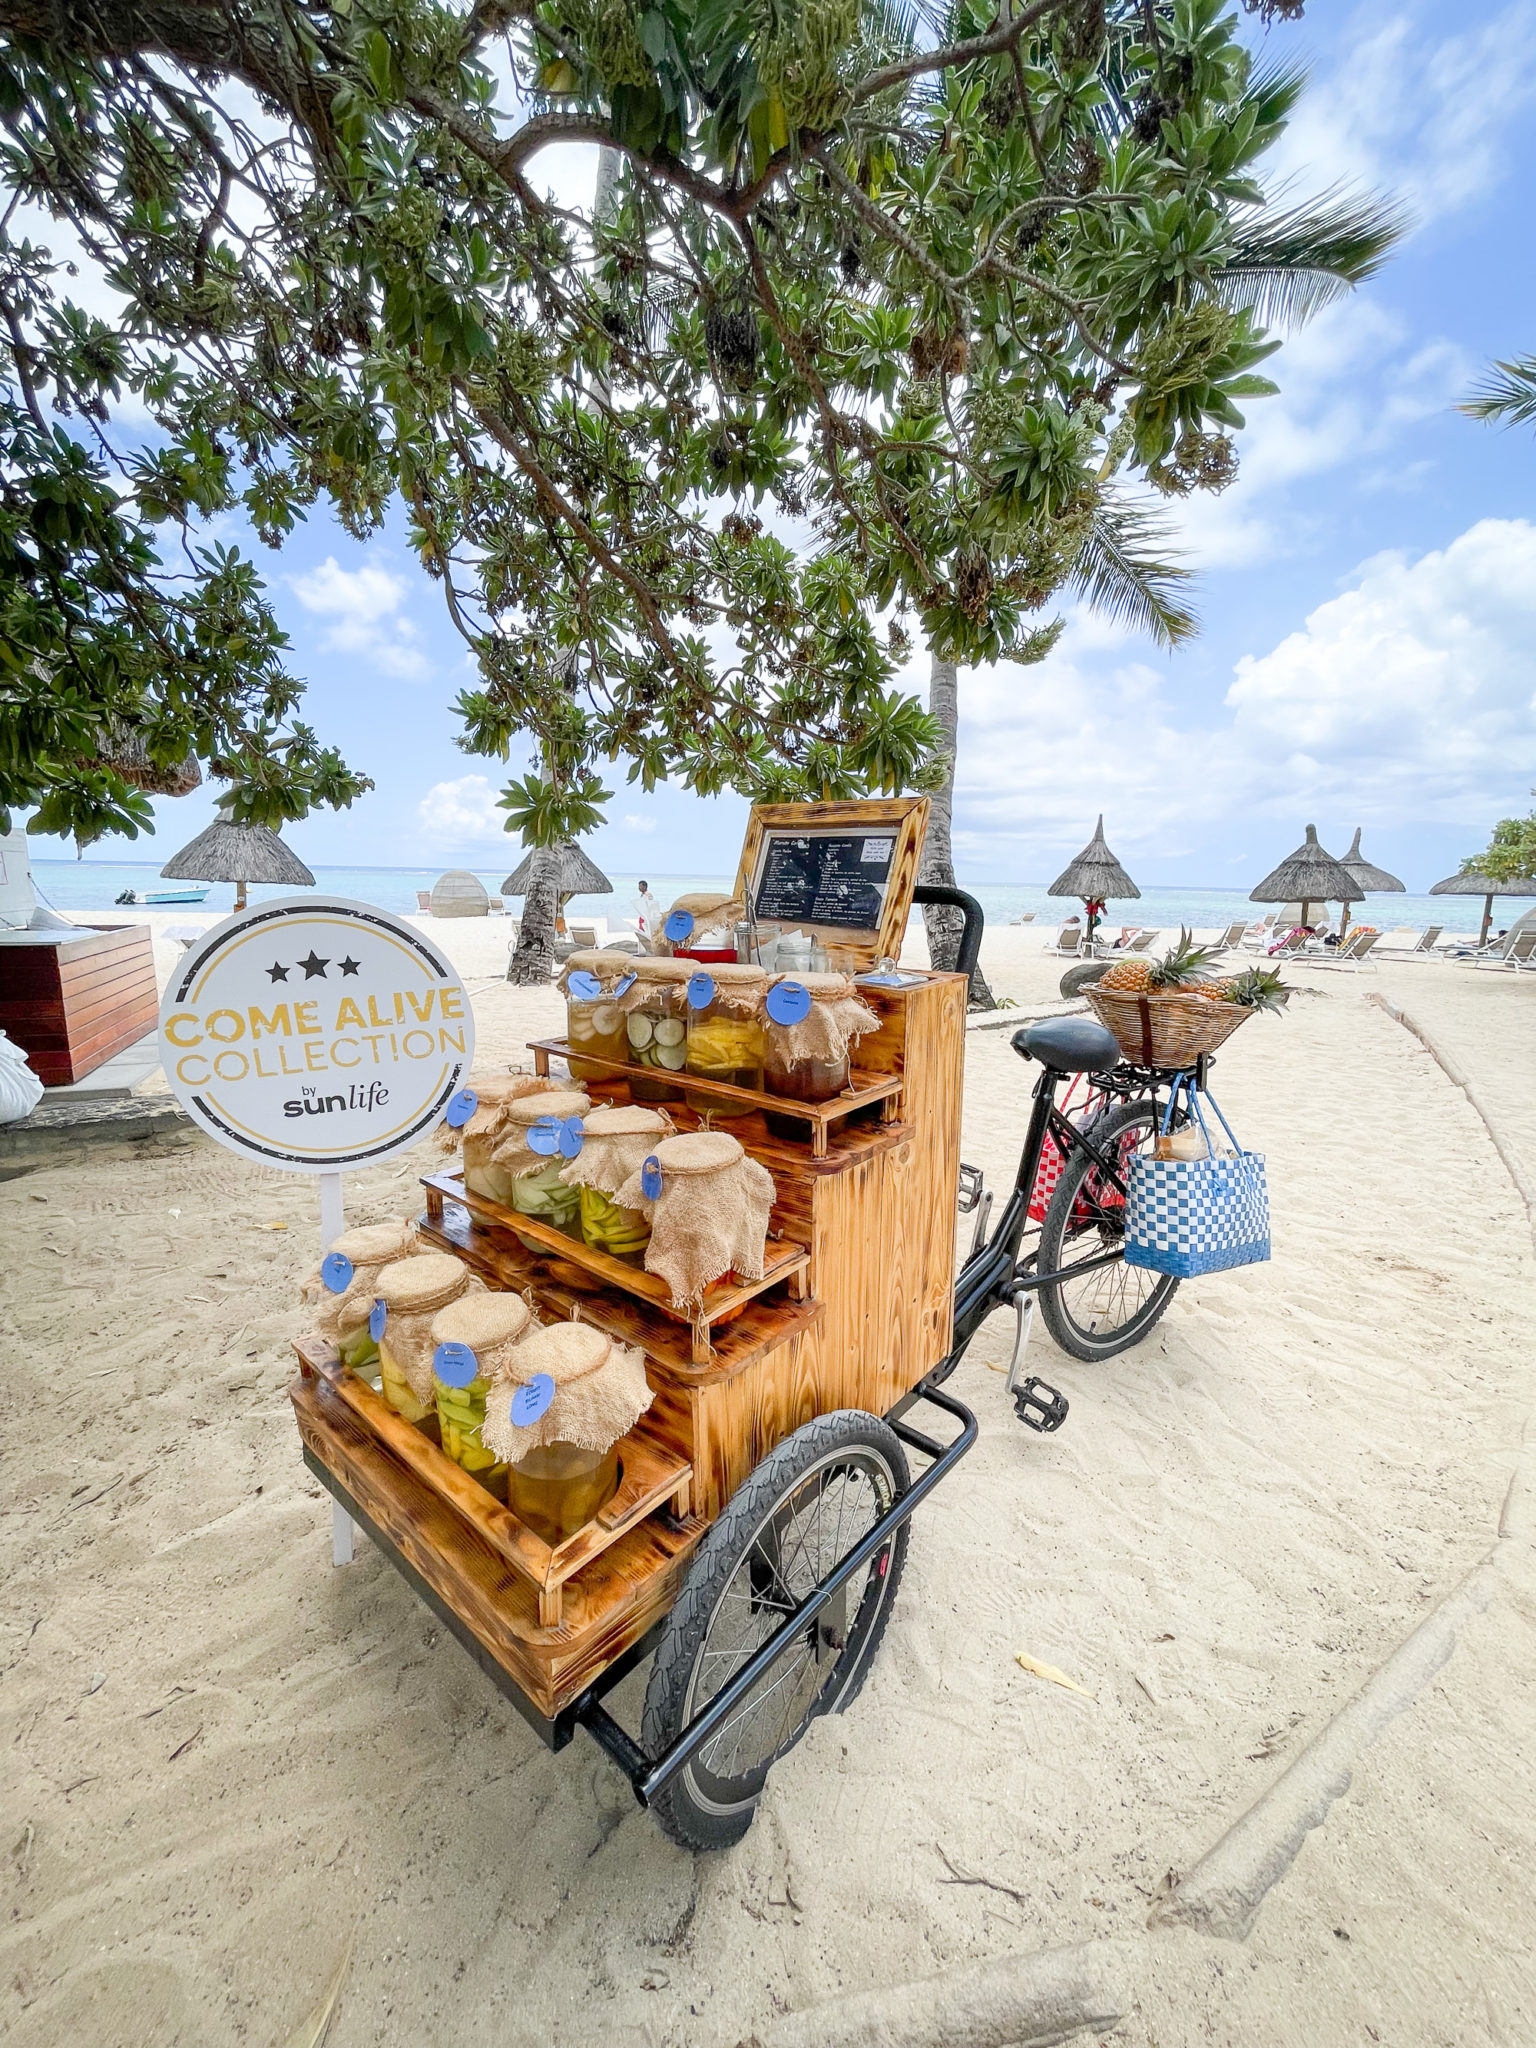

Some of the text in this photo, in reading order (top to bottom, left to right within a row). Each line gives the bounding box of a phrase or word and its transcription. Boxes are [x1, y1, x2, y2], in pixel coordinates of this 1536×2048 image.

[164, 987, 465, 1047] COME ALIVE
[176, 1026, 466, 1086] COLLECTION
[302, 1086, 317, 1097] by
